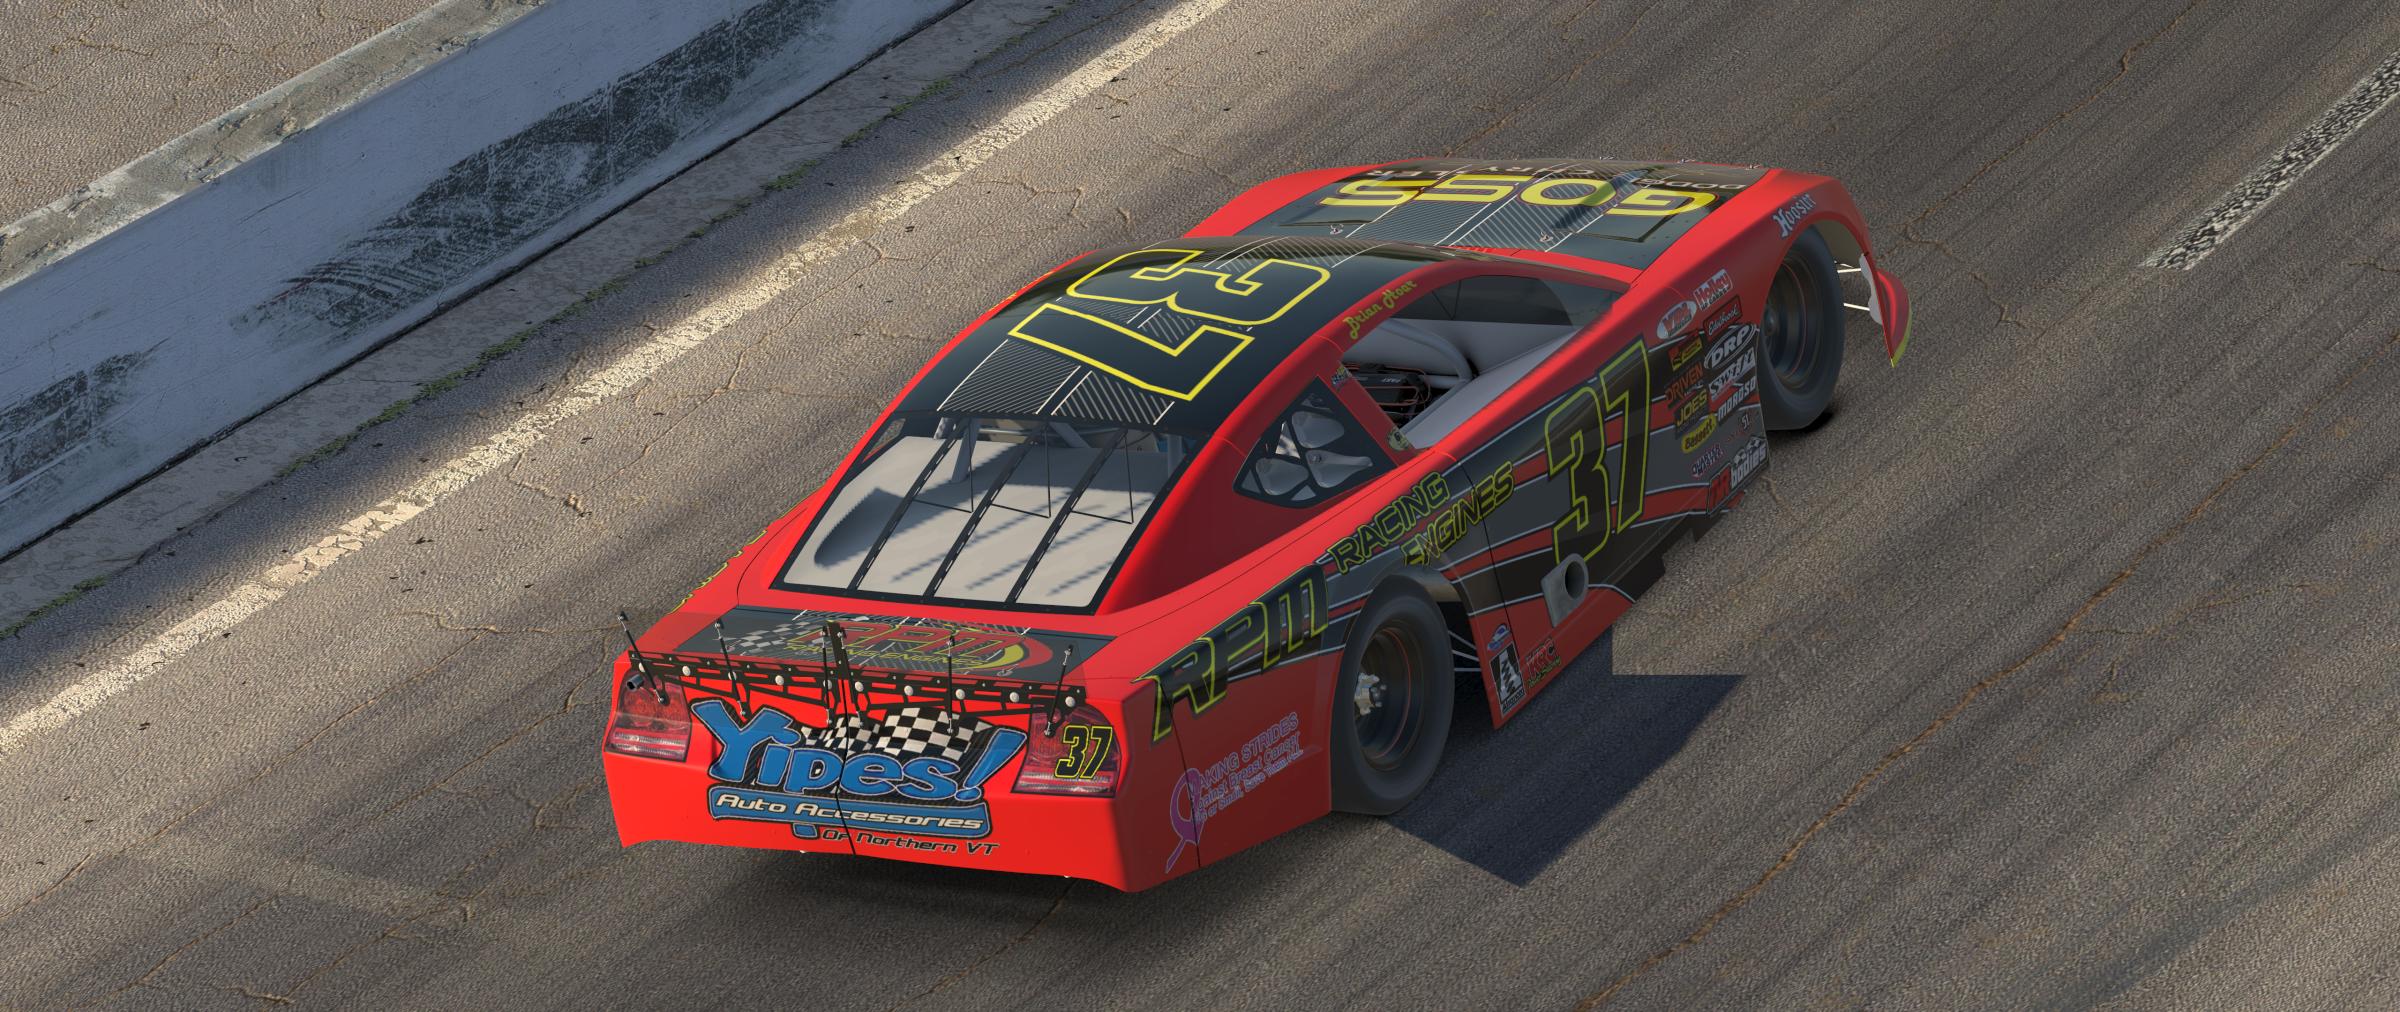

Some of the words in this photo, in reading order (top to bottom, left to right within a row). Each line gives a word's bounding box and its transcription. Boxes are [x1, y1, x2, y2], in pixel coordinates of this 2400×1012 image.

[1319, 174, 1720, 217] GOSS
[1008, 249, 1331, 402] 37
[1711, 324, 1750, 369] DRP
[1664, 360, 1705, 402] DRIVEN
[1676, 388, 1708, 427] JOES
[1545, 339, 1650, 564] 37
[1327, 471, 1451, 575] RACING
[1402, 461, 1515, 568] ENGINES
[786, 620, 1027, 658] RPM
[1131, 563, 1330, 742] RPM
[691, 700, 1027, 801] Yipes!
[1053, 724, 1114, 779] 37
[1241, 711, 1299, 763] STRIDES
[716, 794, 787, 814] Auto
[795, 803, 985, 831] Accessories
[857, 832, 966, 854] Northern
[967, 843, 1001, 856] VT
